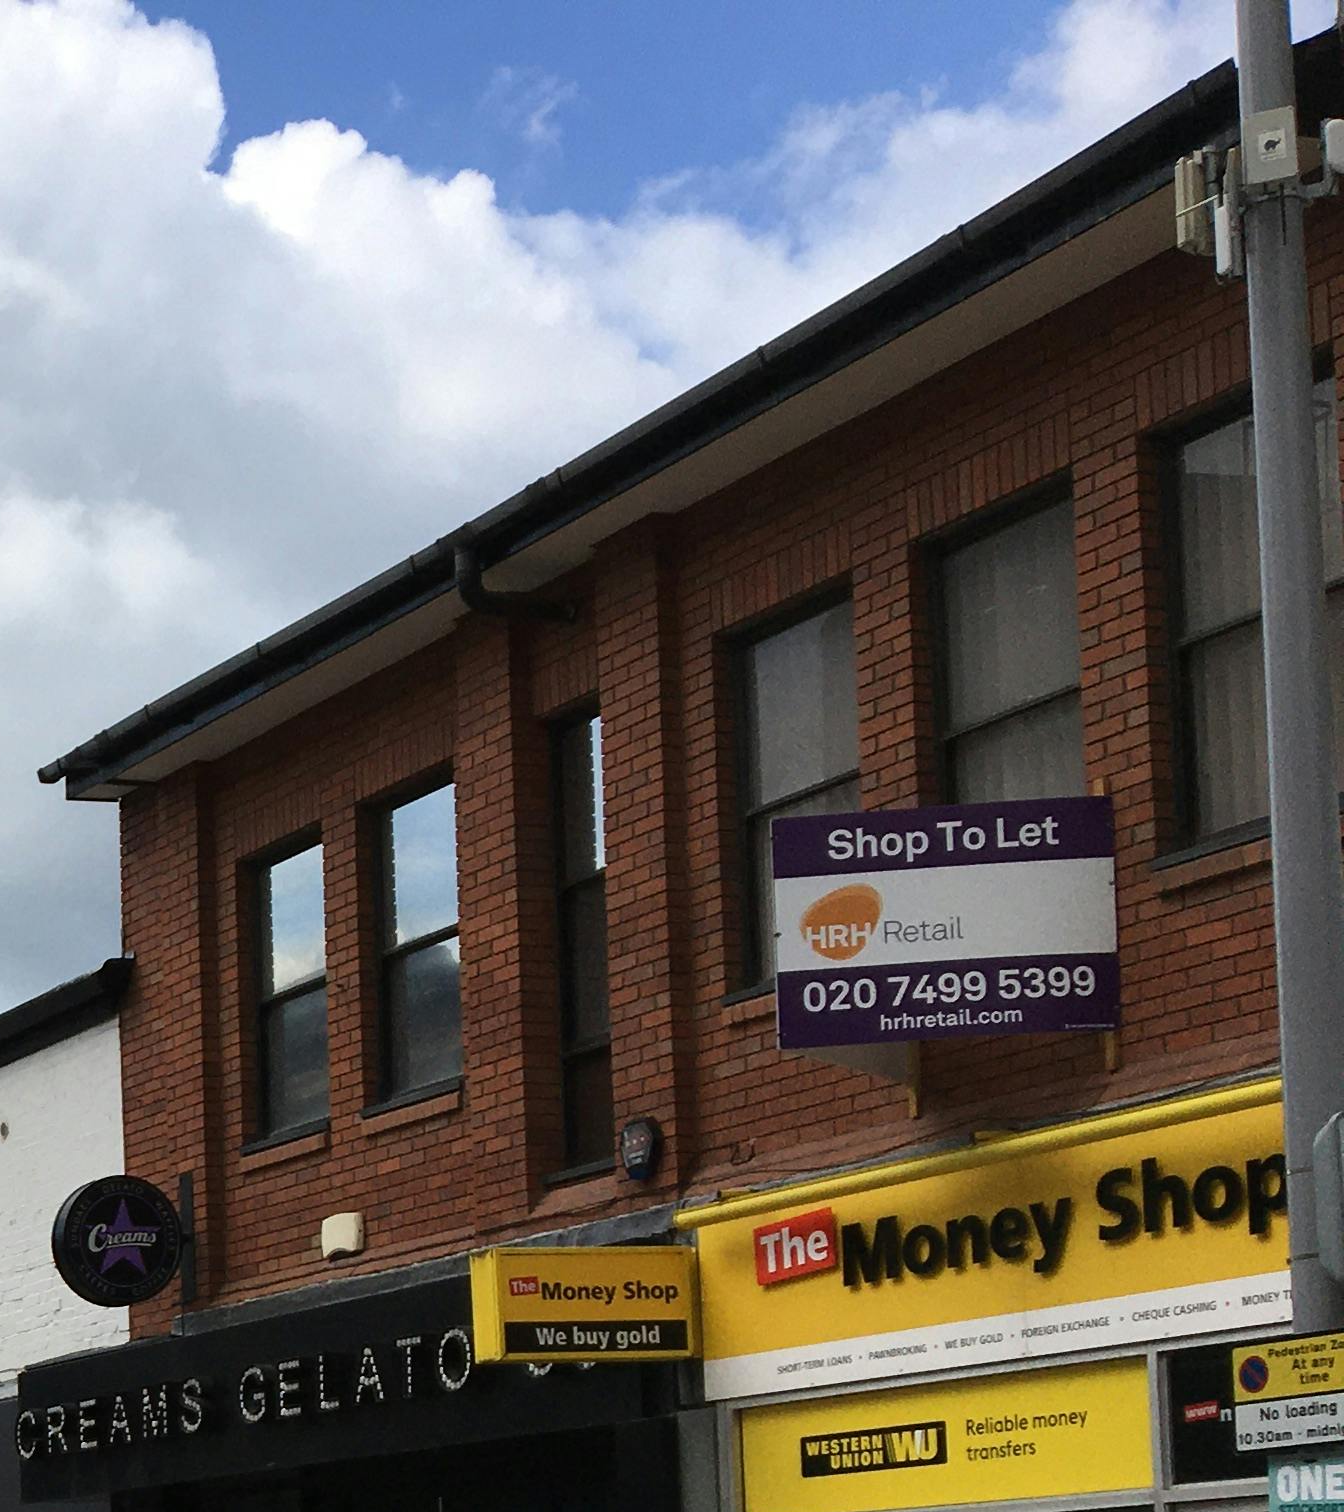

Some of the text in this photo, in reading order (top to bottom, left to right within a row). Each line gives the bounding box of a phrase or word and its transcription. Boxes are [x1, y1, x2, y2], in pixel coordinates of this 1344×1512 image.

[827, 816, 1060, 863] Shop To Let
[805, 916, 964, 949] HRH Retail
[803, 965, 1096, 1013] 020 7499 5399
[880, 1008, 1024, 1031] hrhretail.com
[760, 1152, 1288, 1288] The Money Shop
[88, 1223, 157, 1253] Creams
[511, 1279, 680, 1305] The Money Shop
[535, 1325, 662, 1350] We buy gold
[776, 1290, 1281, 1375] SHORT-TERM LOANS PAWNBROKING WE BUY GOLD FOREIGN EXCHANGE CHEQUE CASHING MONEY
[1267, 1341, 1328, 1358] Pedestrian
[1291, 1356, 1335, 1371] At any
[1298, 1371, 1330, 1385] time
[15, 1326, 473, 1461] CREAMS GELATO
[965, 1410, 1088, 1437] Reliable money
[1259, 1401, 1338, 1421] No loading
[806, 1428, 939, 1463] WESTERN WU
[965, 1439, 1037, 1462] transfers
[1238, 1430, 1293, 1446] 10.30am
[830, 1450, 883, 1470] UNION
[1276, 1463, 1344, 1503] ONE
